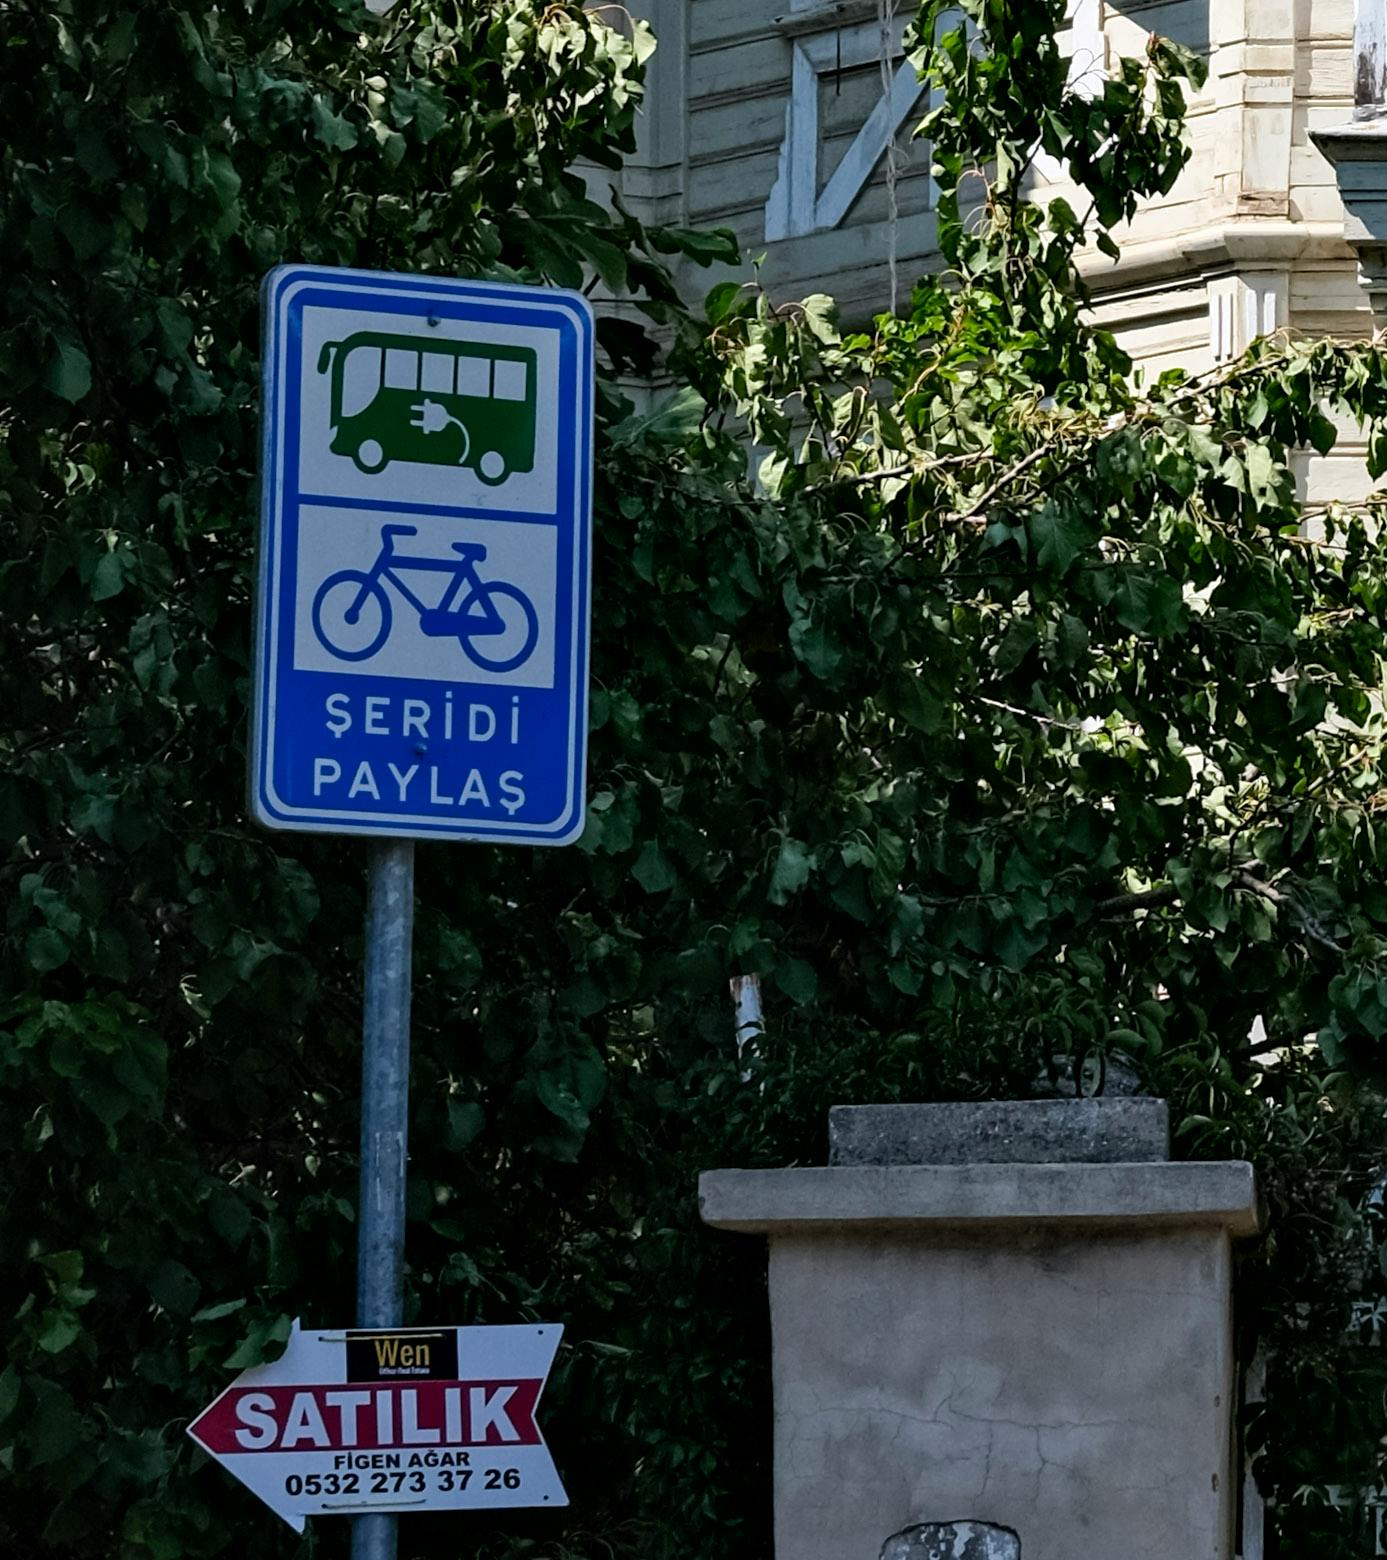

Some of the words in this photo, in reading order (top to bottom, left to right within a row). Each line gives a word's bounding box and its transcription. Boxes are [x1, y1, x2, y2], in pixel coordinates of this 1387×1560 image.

[324, 689, 521, 745] ŞERİDİ
[313, 758, 526, 816] PAYLAŞ
[374, 1338, 430, 1367] Wen
[234, 1386, 520, 1449] SATILIK
[334, 1451, 400, 1470] FİGEN
[409, 1448, 470, 1468] AĞAR
[286, 1473, 360, 1496] 0532
[371, 1470, 426, 1493] 273
[438, 1470, 473, 1491] 37
[485, 1468, 520, 1490] 26
